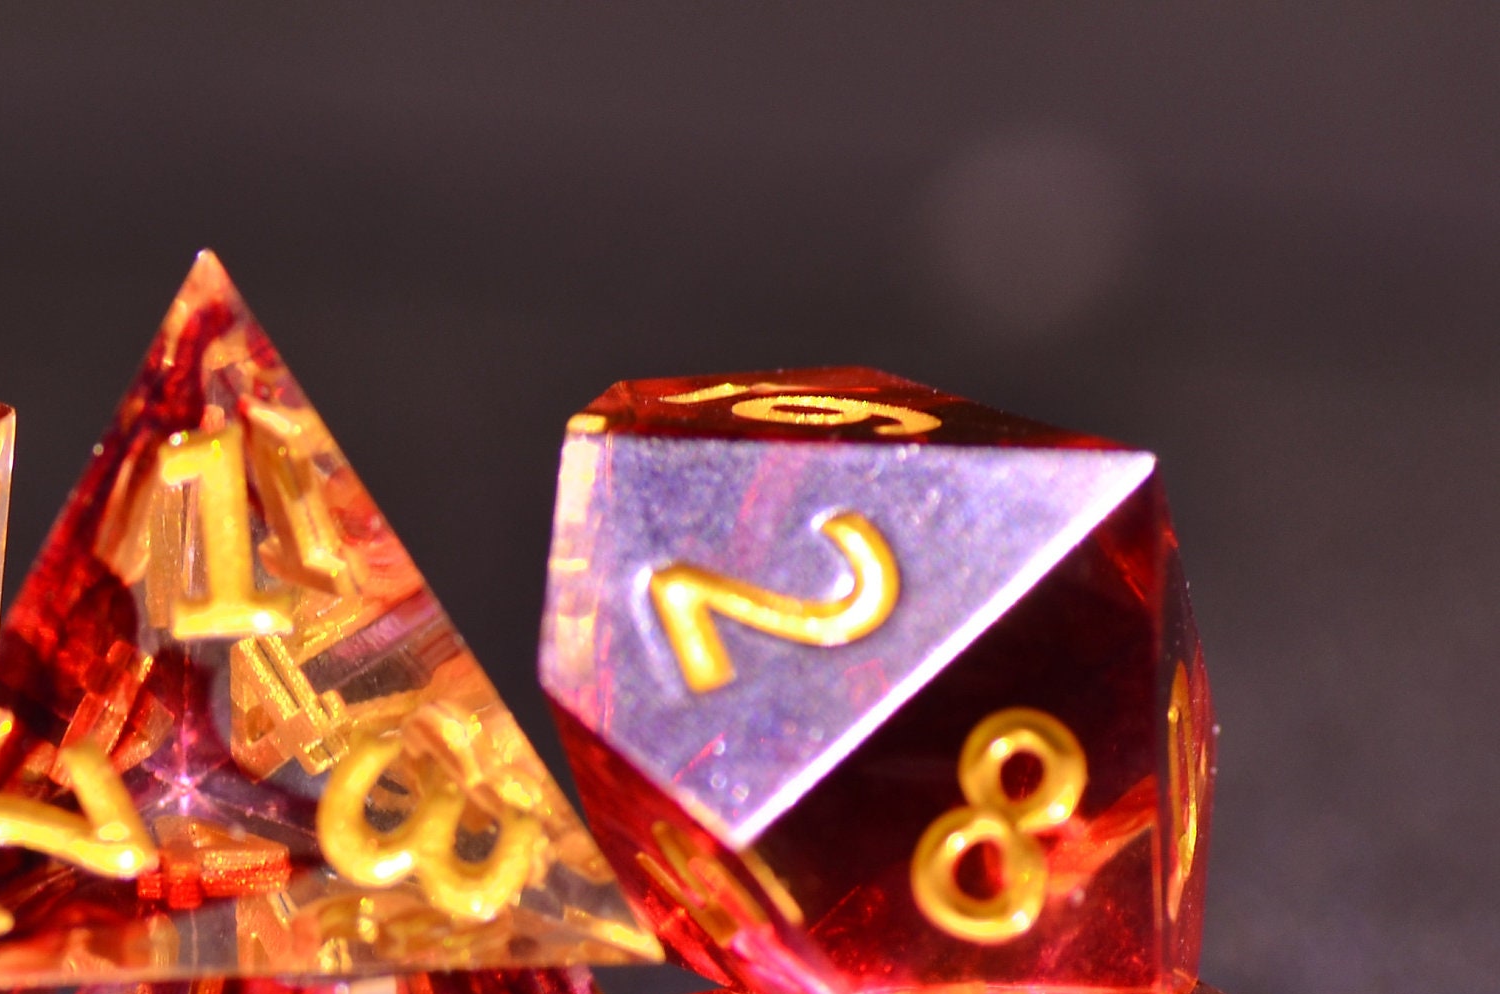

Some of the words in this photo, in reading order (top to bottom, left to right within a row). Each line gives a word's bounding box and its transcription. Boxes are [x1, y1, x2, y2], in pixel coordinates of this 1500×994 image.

[160, 425, 295, 640] 1
[646, 508, 900, 694] 2
[910, 708, 1088, 946] 8
